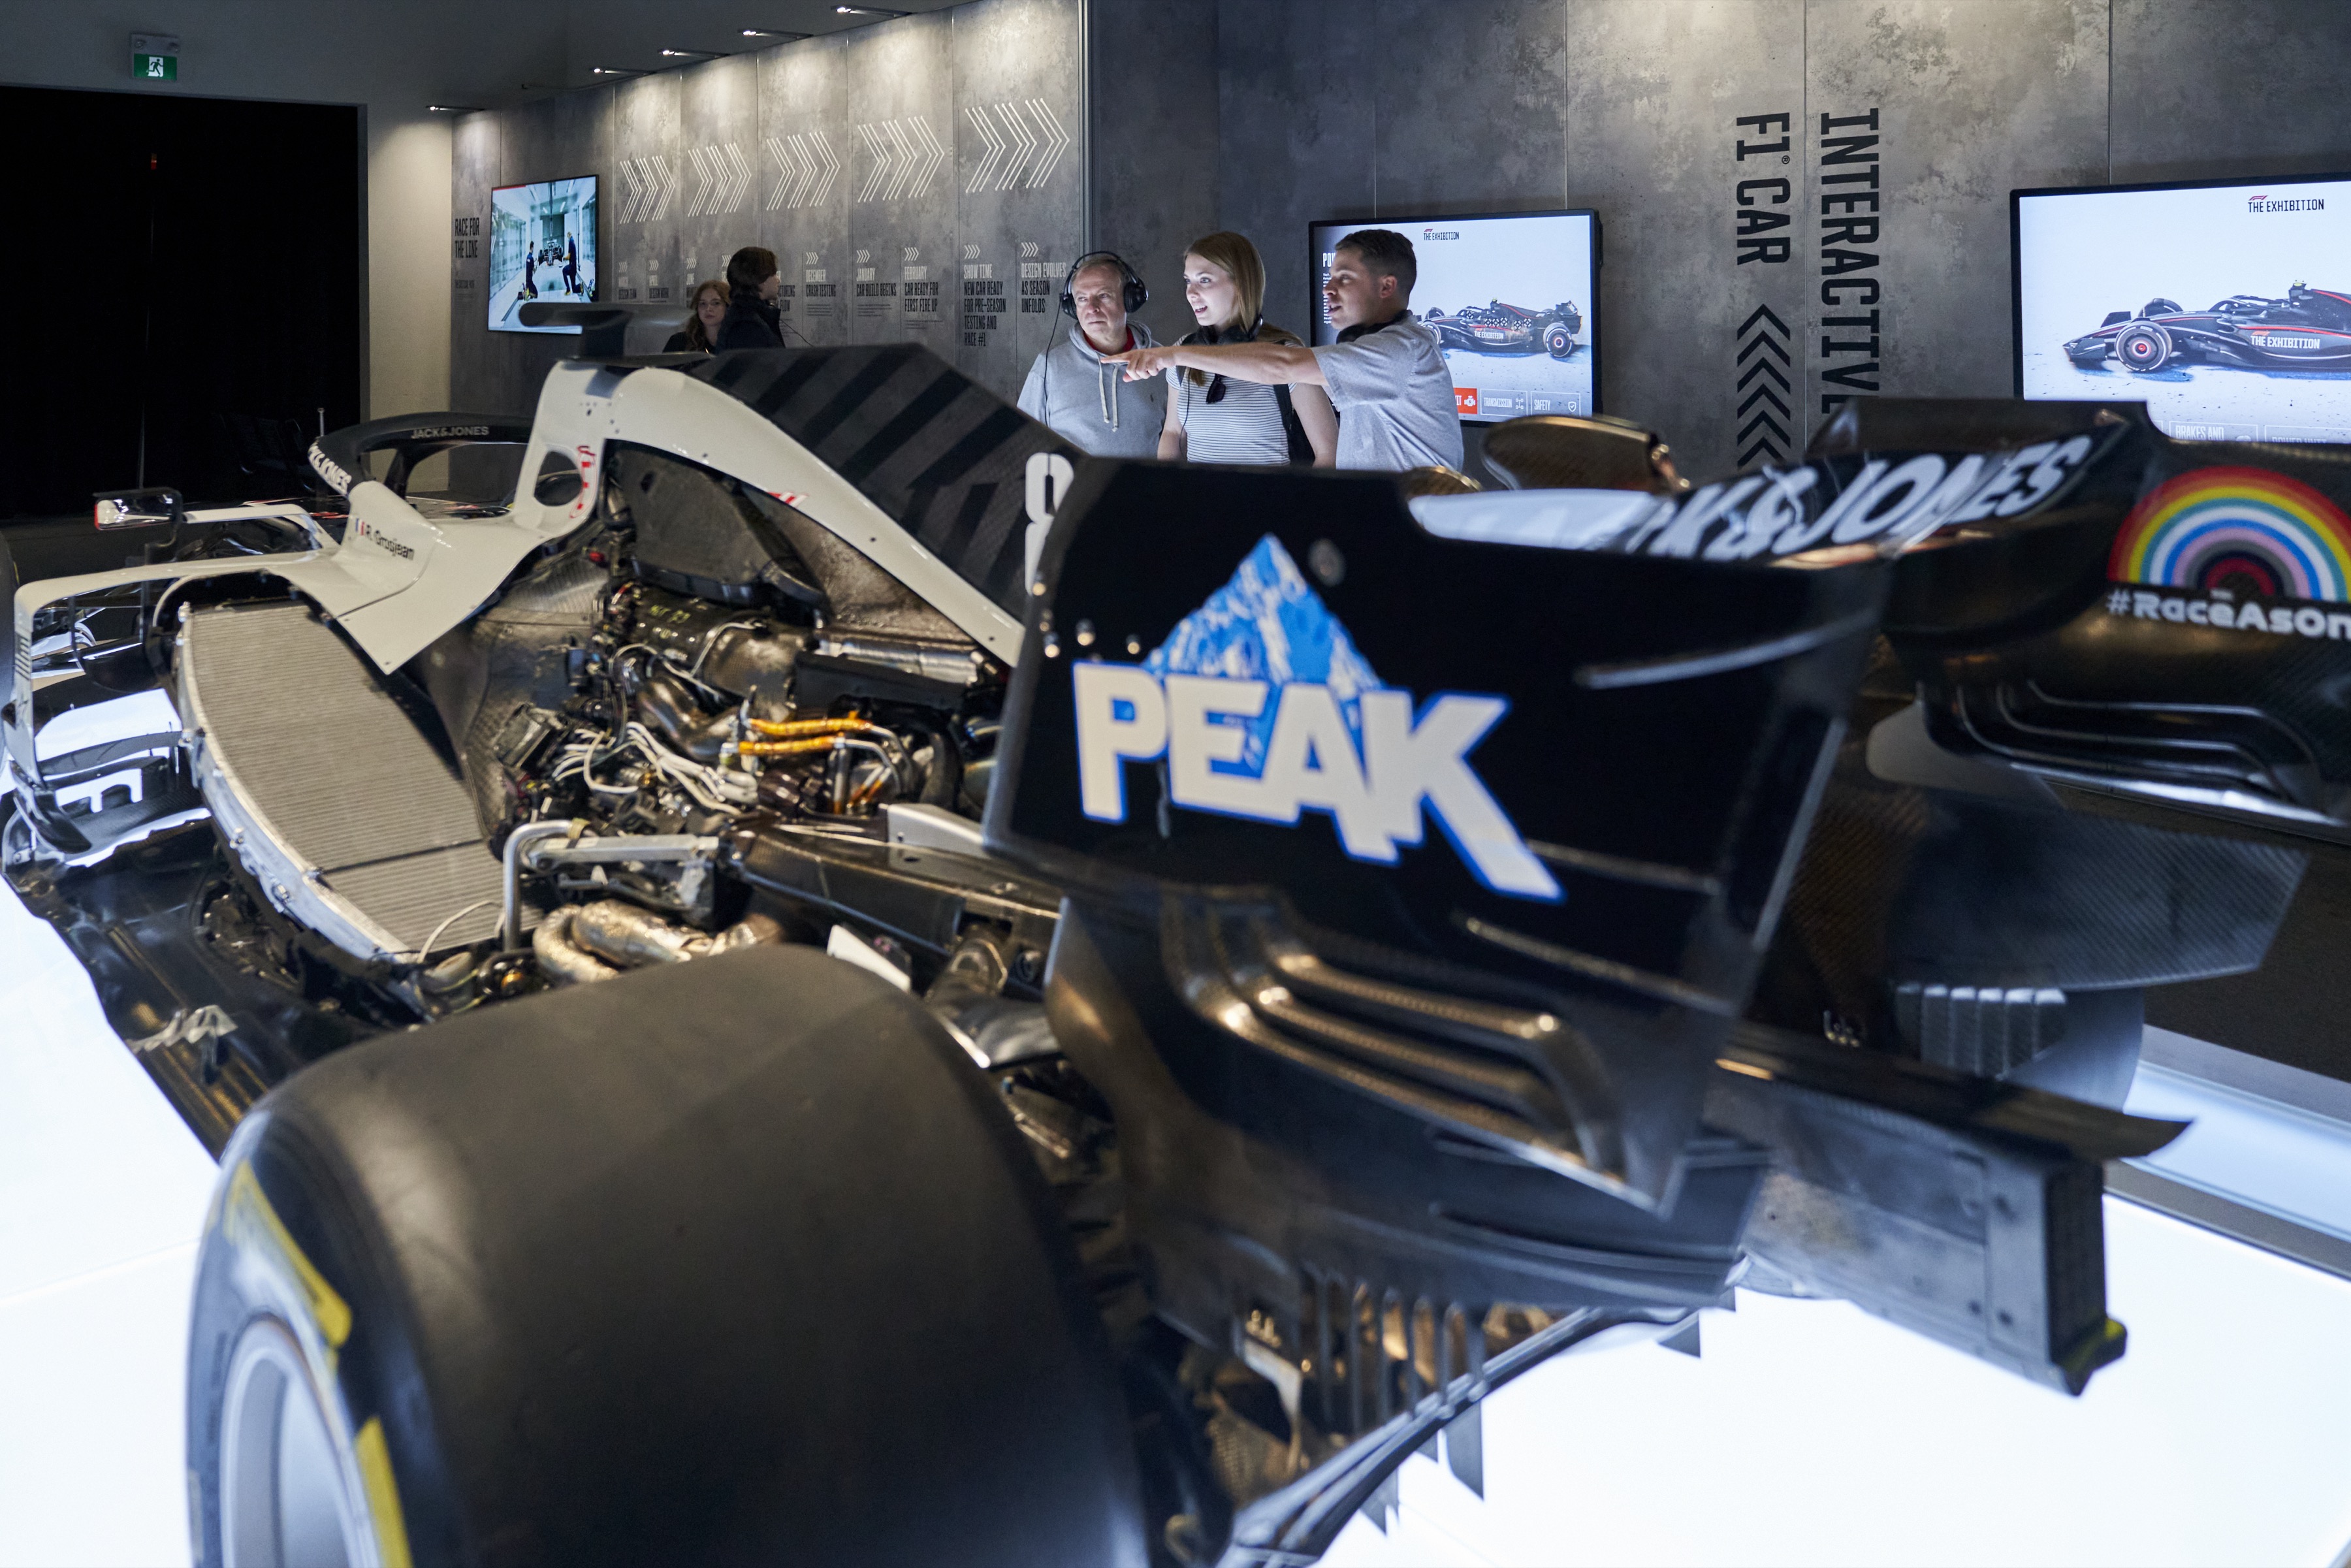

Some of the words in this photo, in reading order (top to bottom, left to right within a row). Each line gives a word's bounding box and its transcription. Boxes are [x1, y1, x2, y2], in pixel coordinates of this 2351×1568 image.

[2248, 201, 2263, 212] THE
[2267, 199, 2324, 212] EXHIBITION
[455, 218, 468, 236] RACE
[470, 217, 480, 236] FOR
[1736, 178, 1791, 265] CAR
[1432, 232, 1460, 240] EXHIBITION
[455, 240, 464, 258] THE
[466, 240, 478, 258] LINE
[856, 268, 876, 281] JANUARY
[904, 266, 927, 280] FEBRUARY
[964, 264, 978, 279] SHOW
[980, 263, 993, 279] TIME
[1021, 263, 1042, 278] DESIGN
[1043, 262, 1066, 278] EVOLVES
[806, 284, 819, 297] CRASH
[820, 284, 836, 297] TESTING
[856, 283, 865, 296] CAR
[866, 283, 879, 296] BUILD
[880, 283, 897, 296] BEGINS
[904, 282, 914, 296] CAR
[914, 282, 929, 296] READY
[930, 281, 938, 295] FOR
[964, 281, 974, 296] NEW
[976, 281, 986, 295] CAR
[987, 281, 1003, 295] READY
[1021, 281, 1029, 295] AS
[1030, 281, 1050, 295] SEASON
[904, 298, 919, 312] FIRST
[920, 298, 931, 312] FIRE
[931, 298, 938, 312] UP
[964, 298, 974, 313] FOR
[975, 298, 1006, 313] PRE-SEASON
[1021, 298, 1046, 313] UNFOLDS
[965, 315, 985, 330] TESTING
[987, 315, 997, 329] AND
[965, 332, 976, 346] RACE
[978, 332, 986, 346] #1
[2250, 335, 2266, 346] THE
[2267, 336, 2320, 349] EXHIBITION
[1484, 397, 1512, 408] TRANSMISSION
[1535, 399, 1550, 411] SAFETY
[2175, 425, 2206, 440] BRAKES
[2208, 426, 2224, 441] AND
[2105, 588, 2351, 640] #RaceAsOn
[1072, 660, 1566, 905] PEAK
